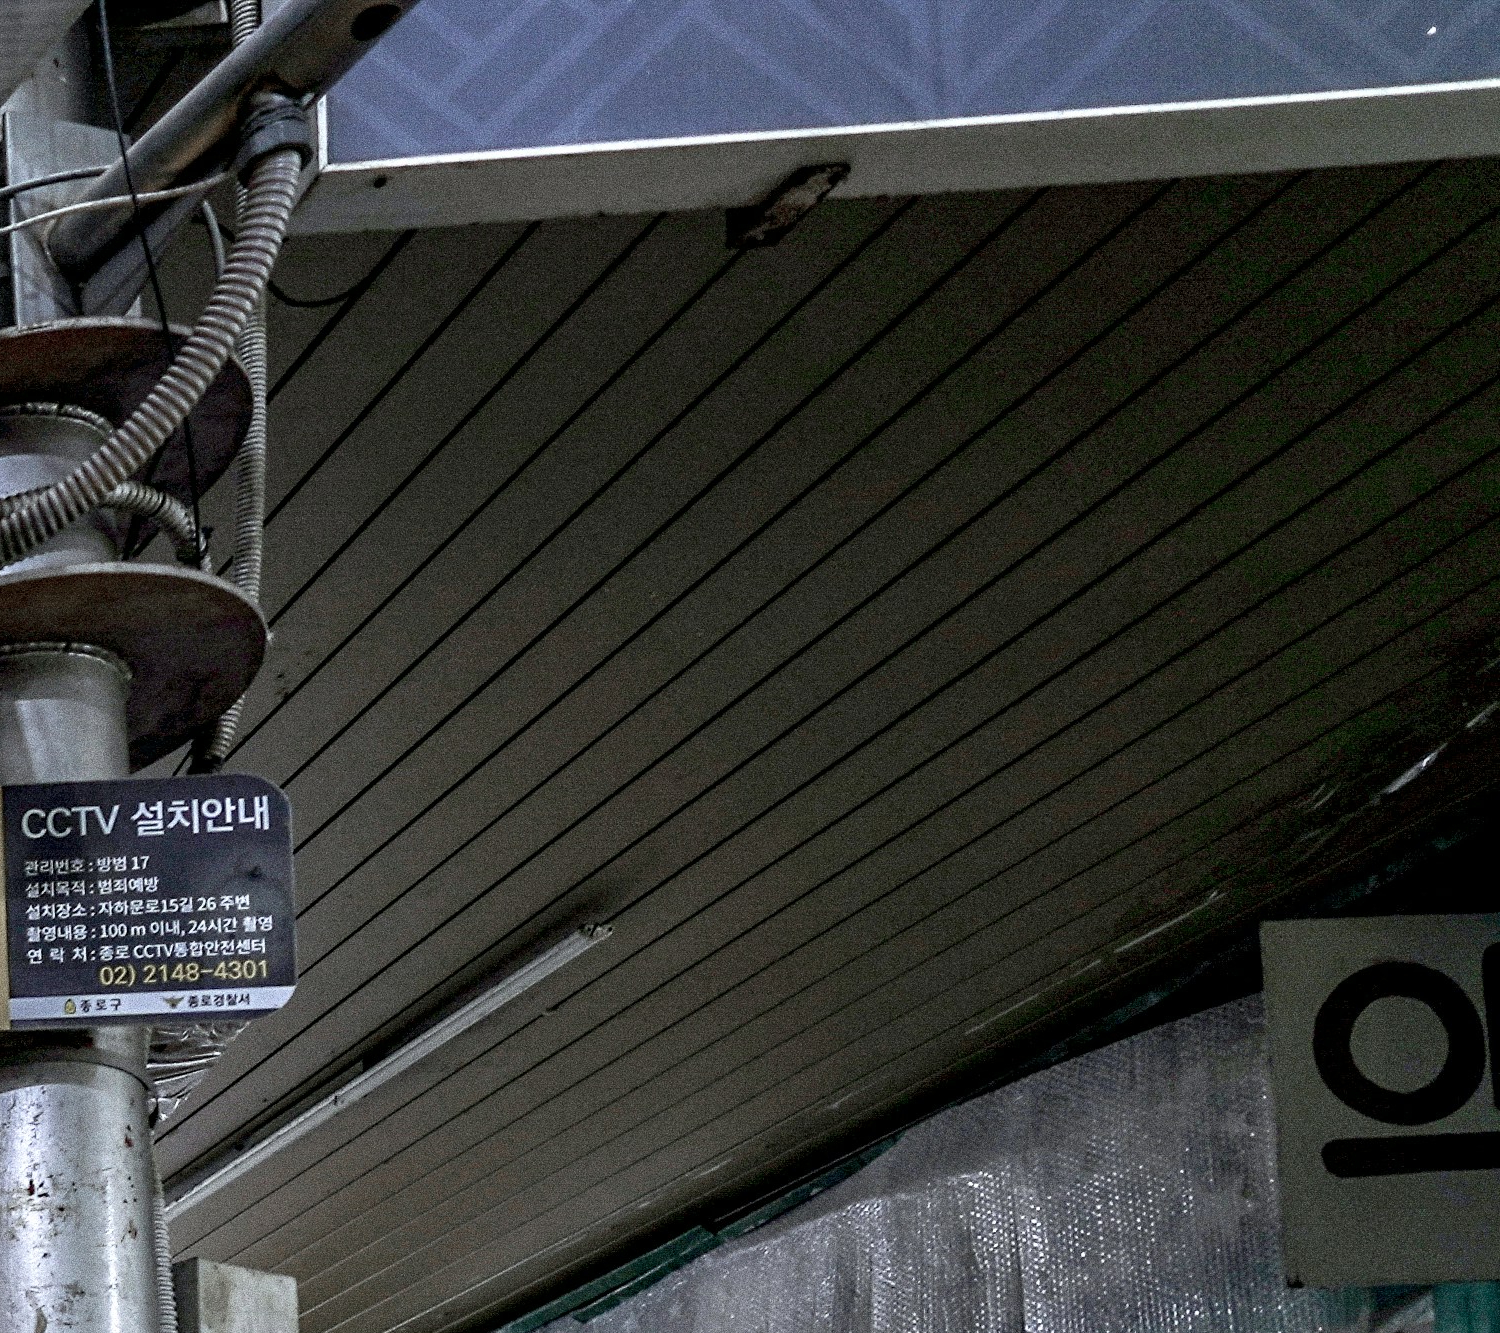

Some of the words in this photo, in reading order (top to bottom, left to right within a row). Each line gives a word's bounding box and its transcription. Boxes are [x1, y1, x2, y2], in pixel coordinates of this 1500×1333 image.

[21, 804, 119, 840] CCTV
[130, 794, 270, 838] 설치안내
[25, 857, 84, 875] 관리번호
[132, 856, 149, 871] 17
[26, 879, 85, 897] 설치목적
[98, 876, 159, 894] 범죄예방
[27, 902, 86, 920] 설치장소
[197, 897, 215, 912] 26
[100, 922, 127, 939] 100
[188, 917, 237, 936] 24시간
[100, 964, 137, 987] 02)
[143, 959, 269, 984] 2148-4301
